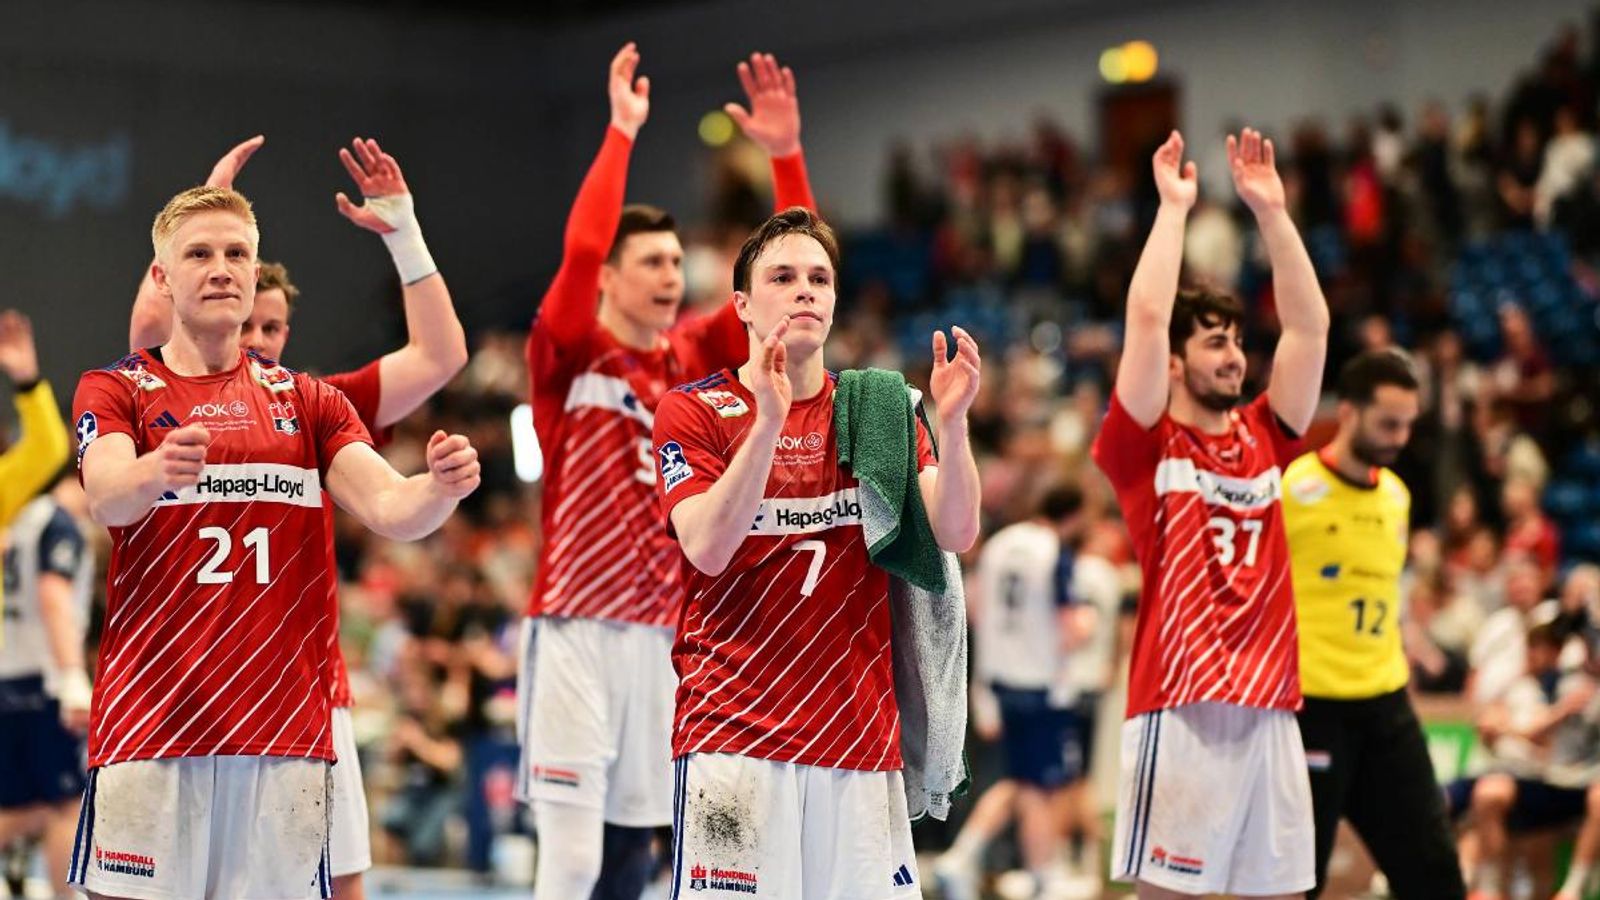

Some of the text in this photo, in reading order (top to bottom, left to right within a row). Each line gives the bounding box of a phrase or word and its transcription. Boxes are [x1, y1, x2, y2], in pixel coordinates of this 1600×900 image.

[189, 403, 230, 417] AOK
[197, 474, 303, 498] Hapag-Lloyd
[1209, 517, 1263, 567] 37
[196, 526, 271, 585] 21
[791, 539, 827, 597] 7
[1349, 598, 1388, 636] 12
[105, 850, 155, 865] HANDBALL
[104, 862, 155, 878] HAMBURG
[711, 868, 757, 883] HANDBALL
[710, 881, 757, 894] HAMBURG
